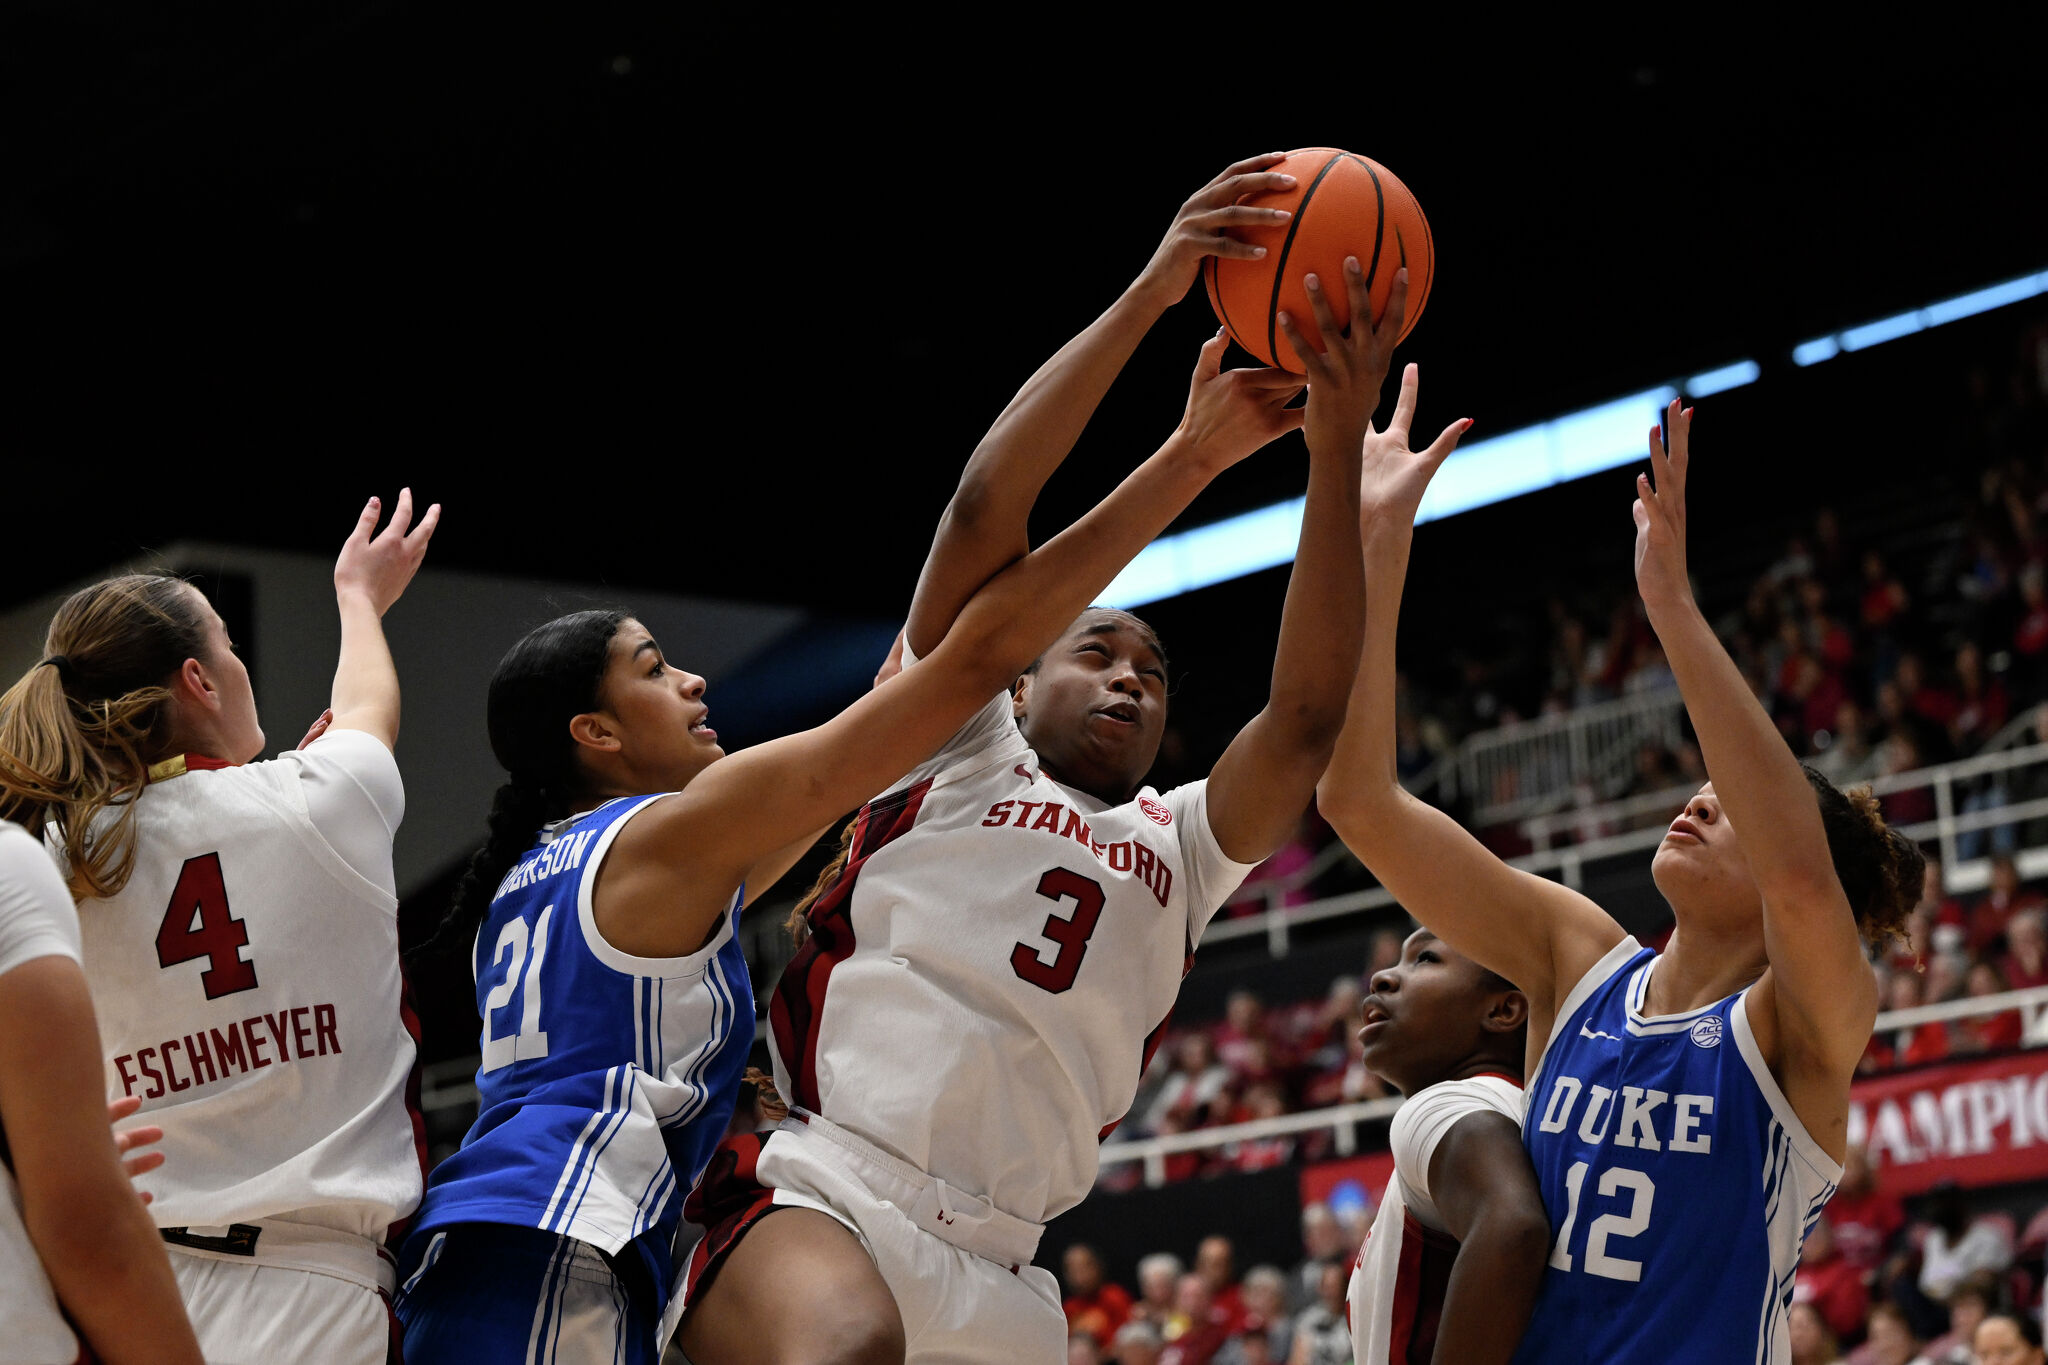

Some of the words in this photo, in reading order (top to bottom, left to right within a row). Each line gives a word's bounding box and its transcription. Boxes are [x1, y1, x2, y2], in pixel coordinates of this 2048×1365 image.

[982, 800, 1173, 908] STANFORD
[155, 851, 258, 1001] 4
[1010, 866, 1106, 994] 3
[483, 904, 553, 1075] 21
[114, 1003, 342, 1101] ESCHMEYER
[1539, 1076, 1714, 1154] DUKE
[1548, 1161, 1655, 1282] 12
